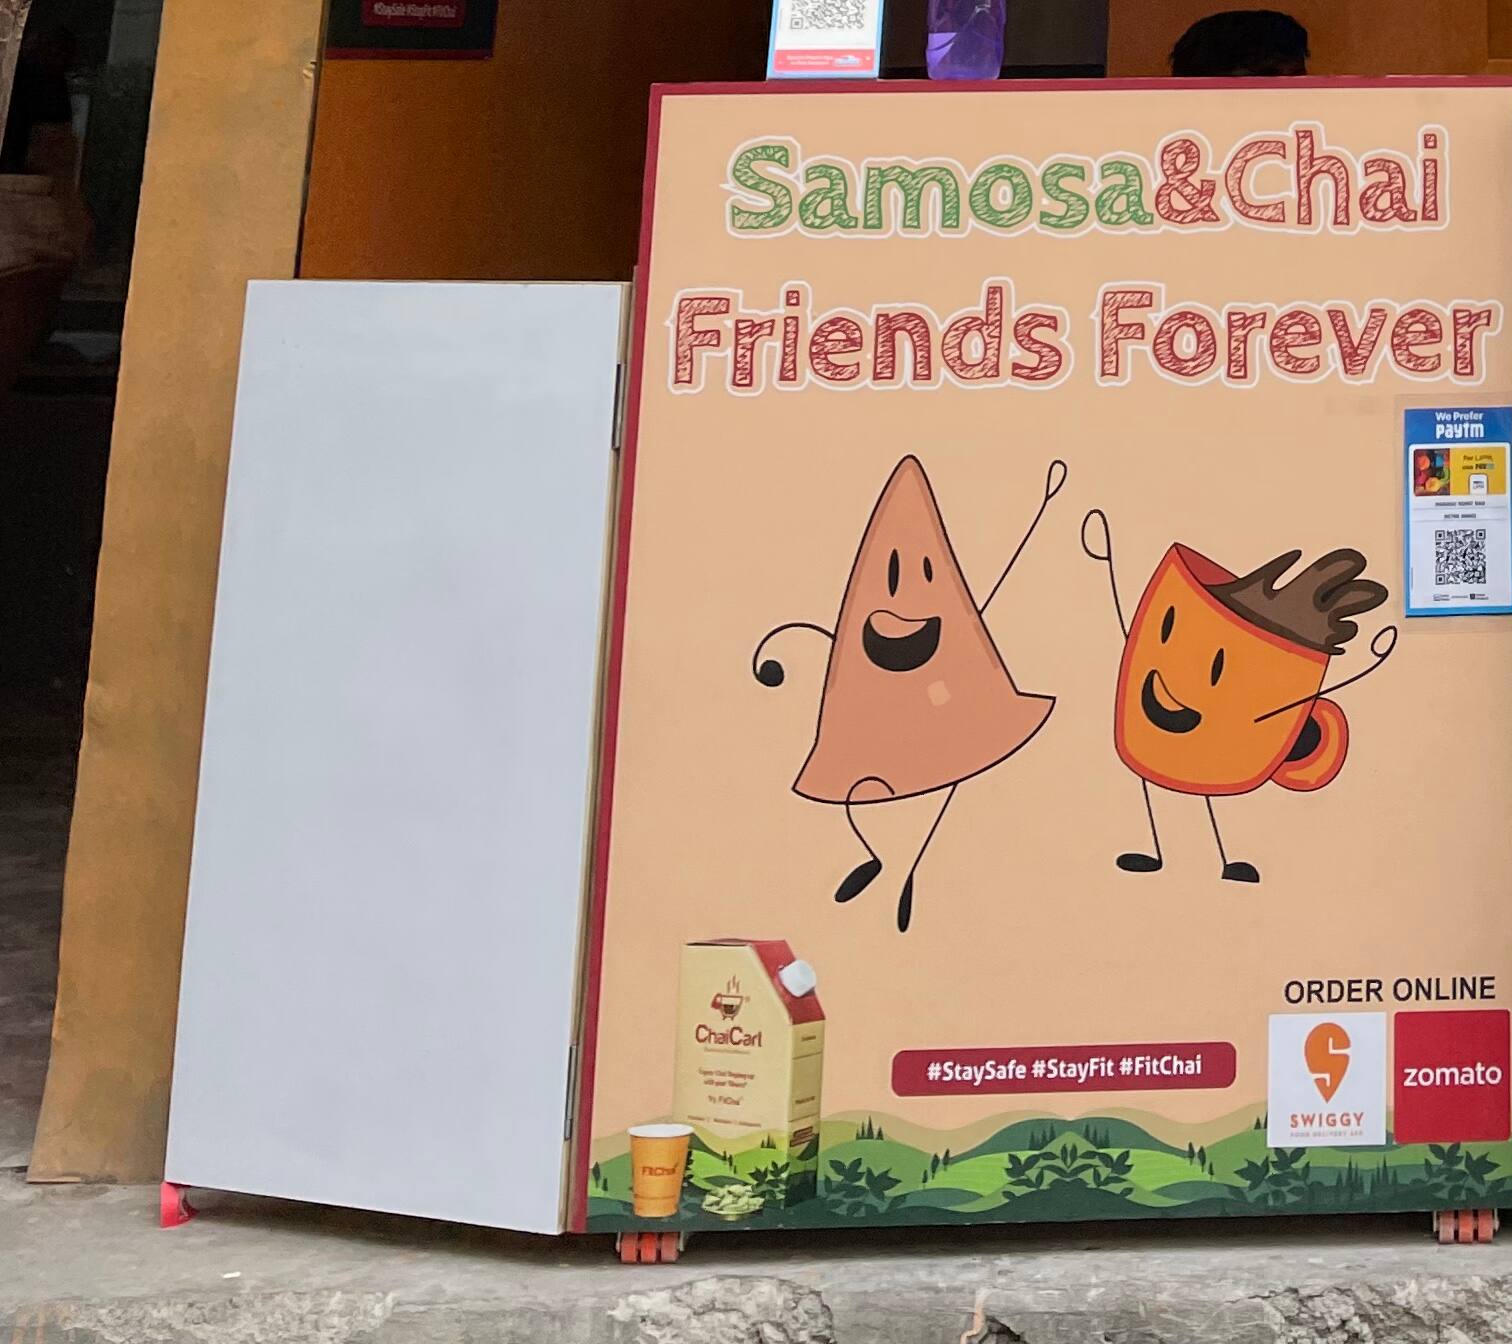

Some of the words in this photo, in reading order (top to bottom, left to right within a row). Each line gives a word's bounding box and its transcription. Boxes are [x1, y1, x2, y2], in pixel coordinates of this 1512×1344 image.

[728, 124, 1442, 231] Samosa&Chai
[673, 285, 1068, 388] Friends
[1098, 290, 1495, 380] Forever
[1453, 411, 1483, 421] Prefer
[1285, 979, 1384, 1004] ORDER
[1393, 976, 1496, 1002] ONLINE
[927, 1058, 1027, 1083] #StaySafe
[1031, 1055, 1114, 1081] #StayFit
[1119, 1052, 1202, 1077] #FitChai
[1403, 1062, 1503, 1087] zomato
[1290, 1112, 1364, 1128] SWIGGY
